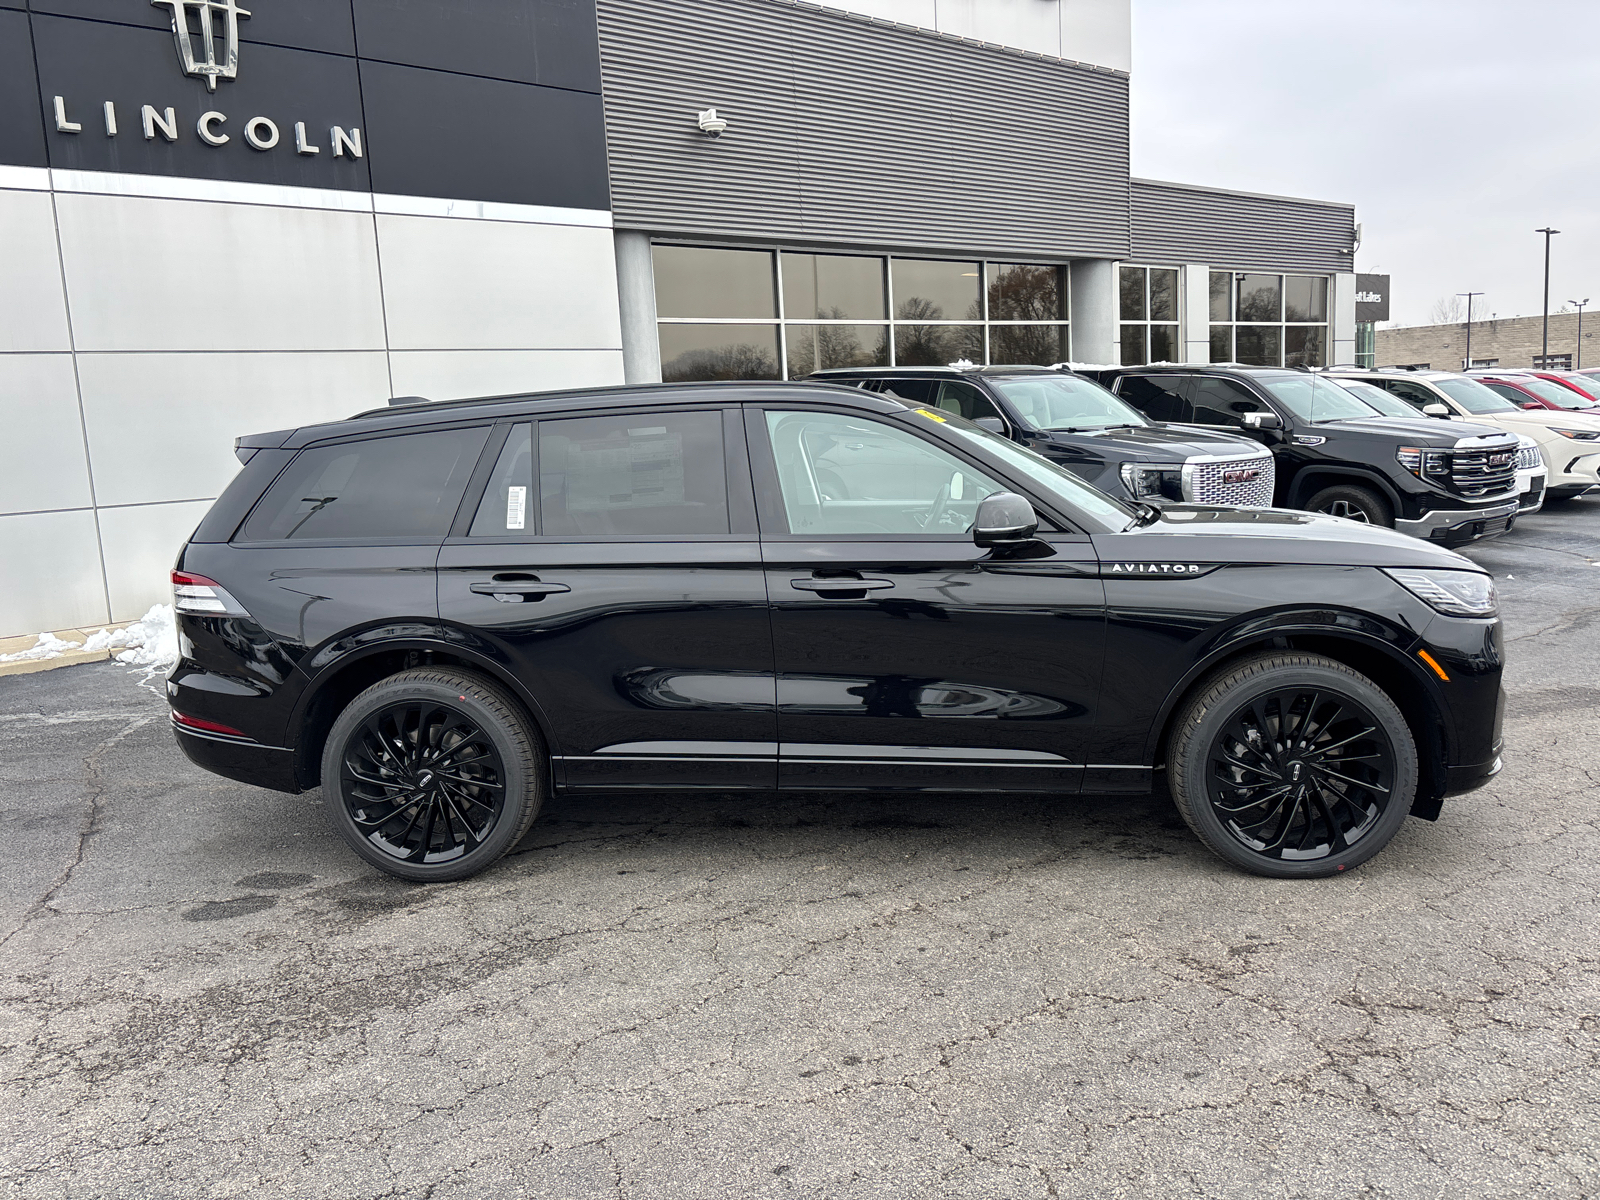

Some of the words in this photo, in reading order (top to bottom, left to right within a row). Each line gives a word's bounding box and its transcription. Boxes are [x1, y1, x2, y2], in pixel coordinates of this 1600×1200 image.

[53, 95, 363, 159] LINCOLN
[1225, 469, 1259, 483] GMC
[1112, 563, 1199, 573] AVIATOR
